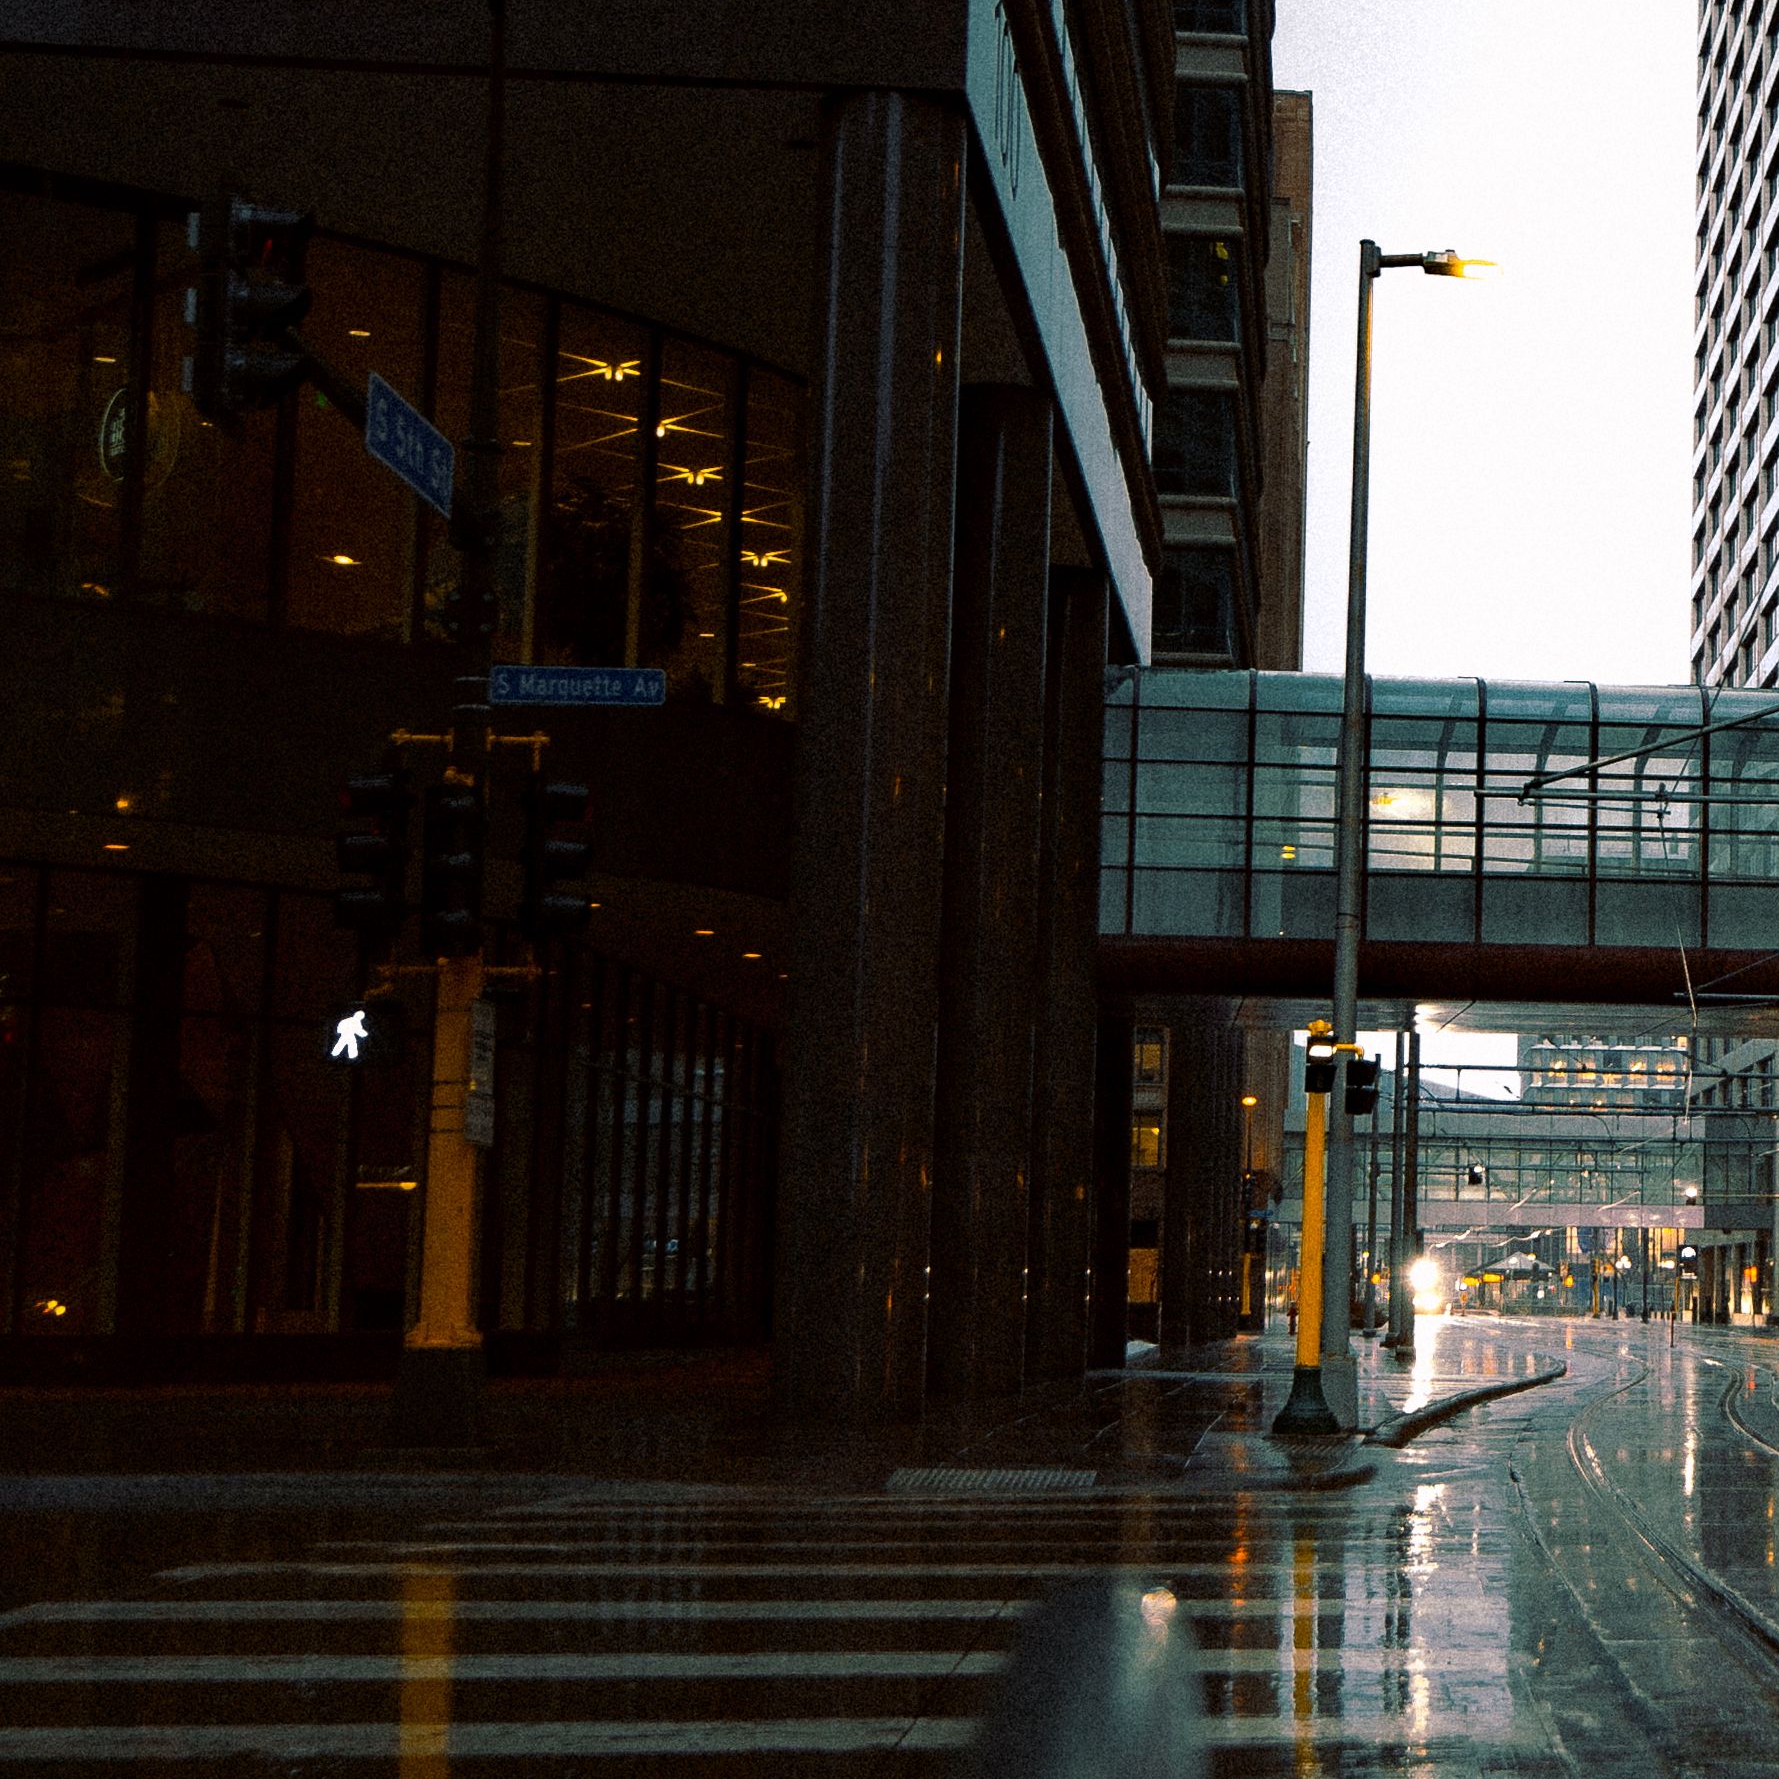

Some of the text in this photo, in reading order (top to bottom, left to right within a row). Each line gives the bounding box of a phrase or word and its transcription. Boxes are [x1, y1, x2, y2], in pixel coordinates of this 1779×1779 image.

[376, 397, 449, 497] S 5th St
[498, 673, 660, 700] S Marquette Av
